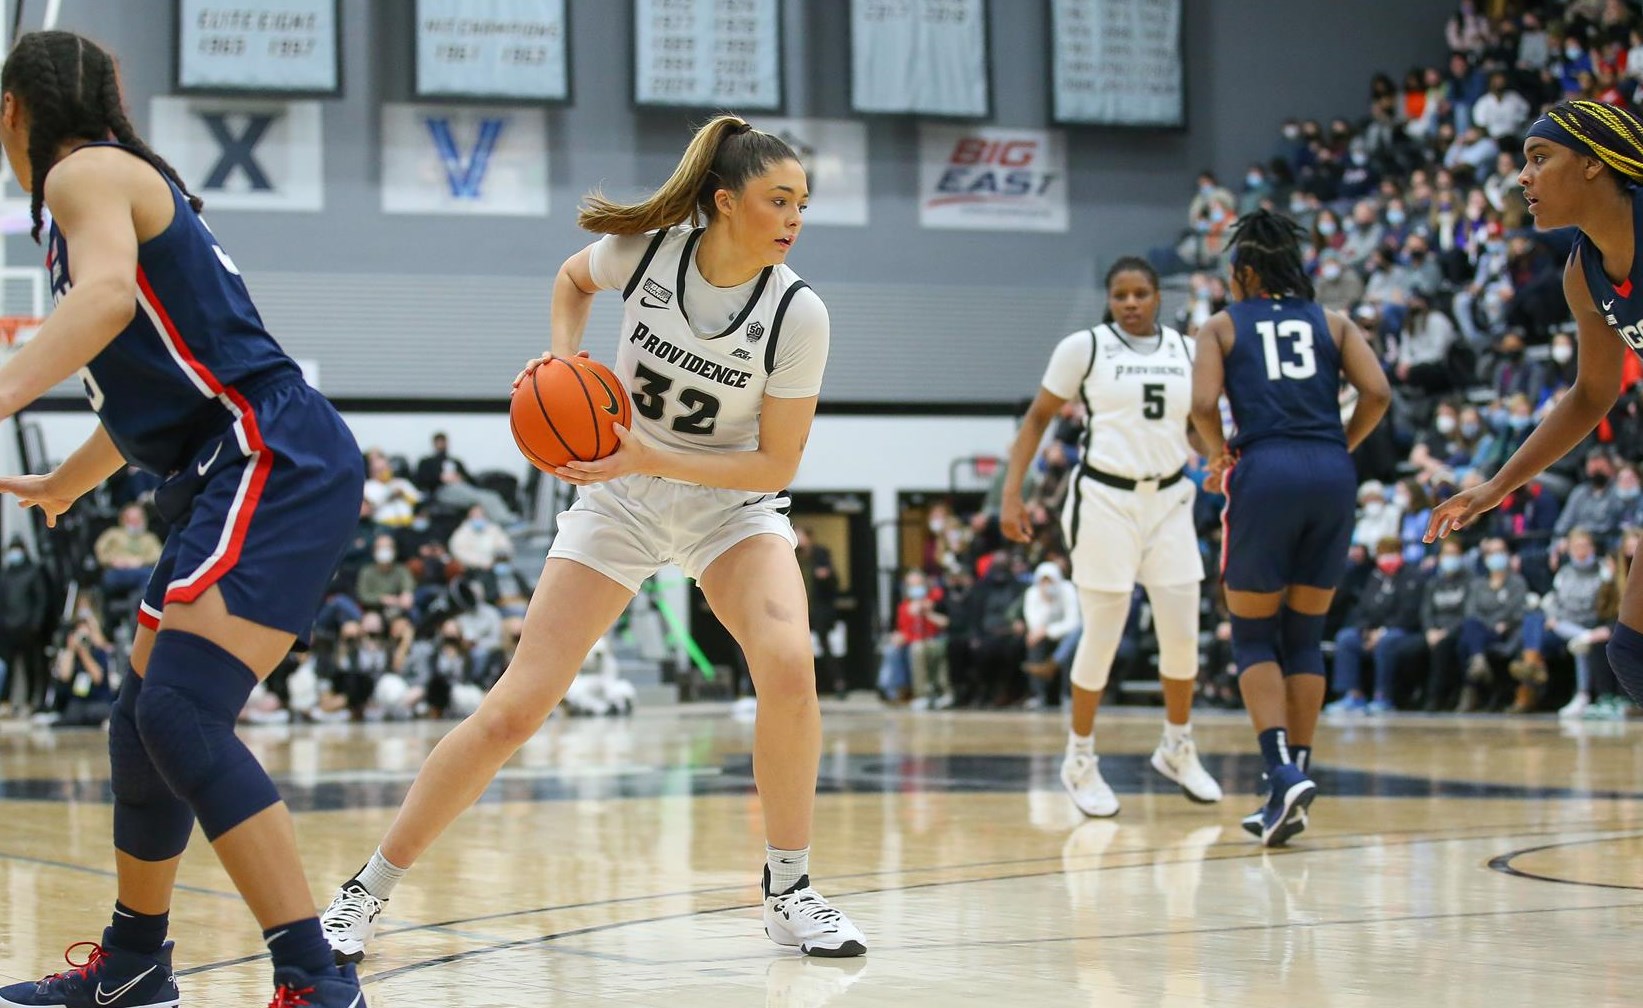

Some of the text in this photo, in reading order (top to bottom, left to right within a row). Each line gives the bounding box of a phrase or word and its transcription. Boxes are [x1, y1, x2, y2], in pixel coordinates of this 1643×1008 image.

[198, 9, 316, 32] ELITE EIGHT
[202, 114, 276, 190] X
[425, 117, 505, 198] V
[950, 137, 1037, 167] BIG
[935, 167, 1060, 197] EAST
[629, 321, 752, 389] PROVIDENCE
[1115, 365, 1185, 380] PROVIDENCE
[1256, 319, 1317, 381] 13
[631, 361, 720, 435] 32
[1143, 383, 1166, 420] 5
